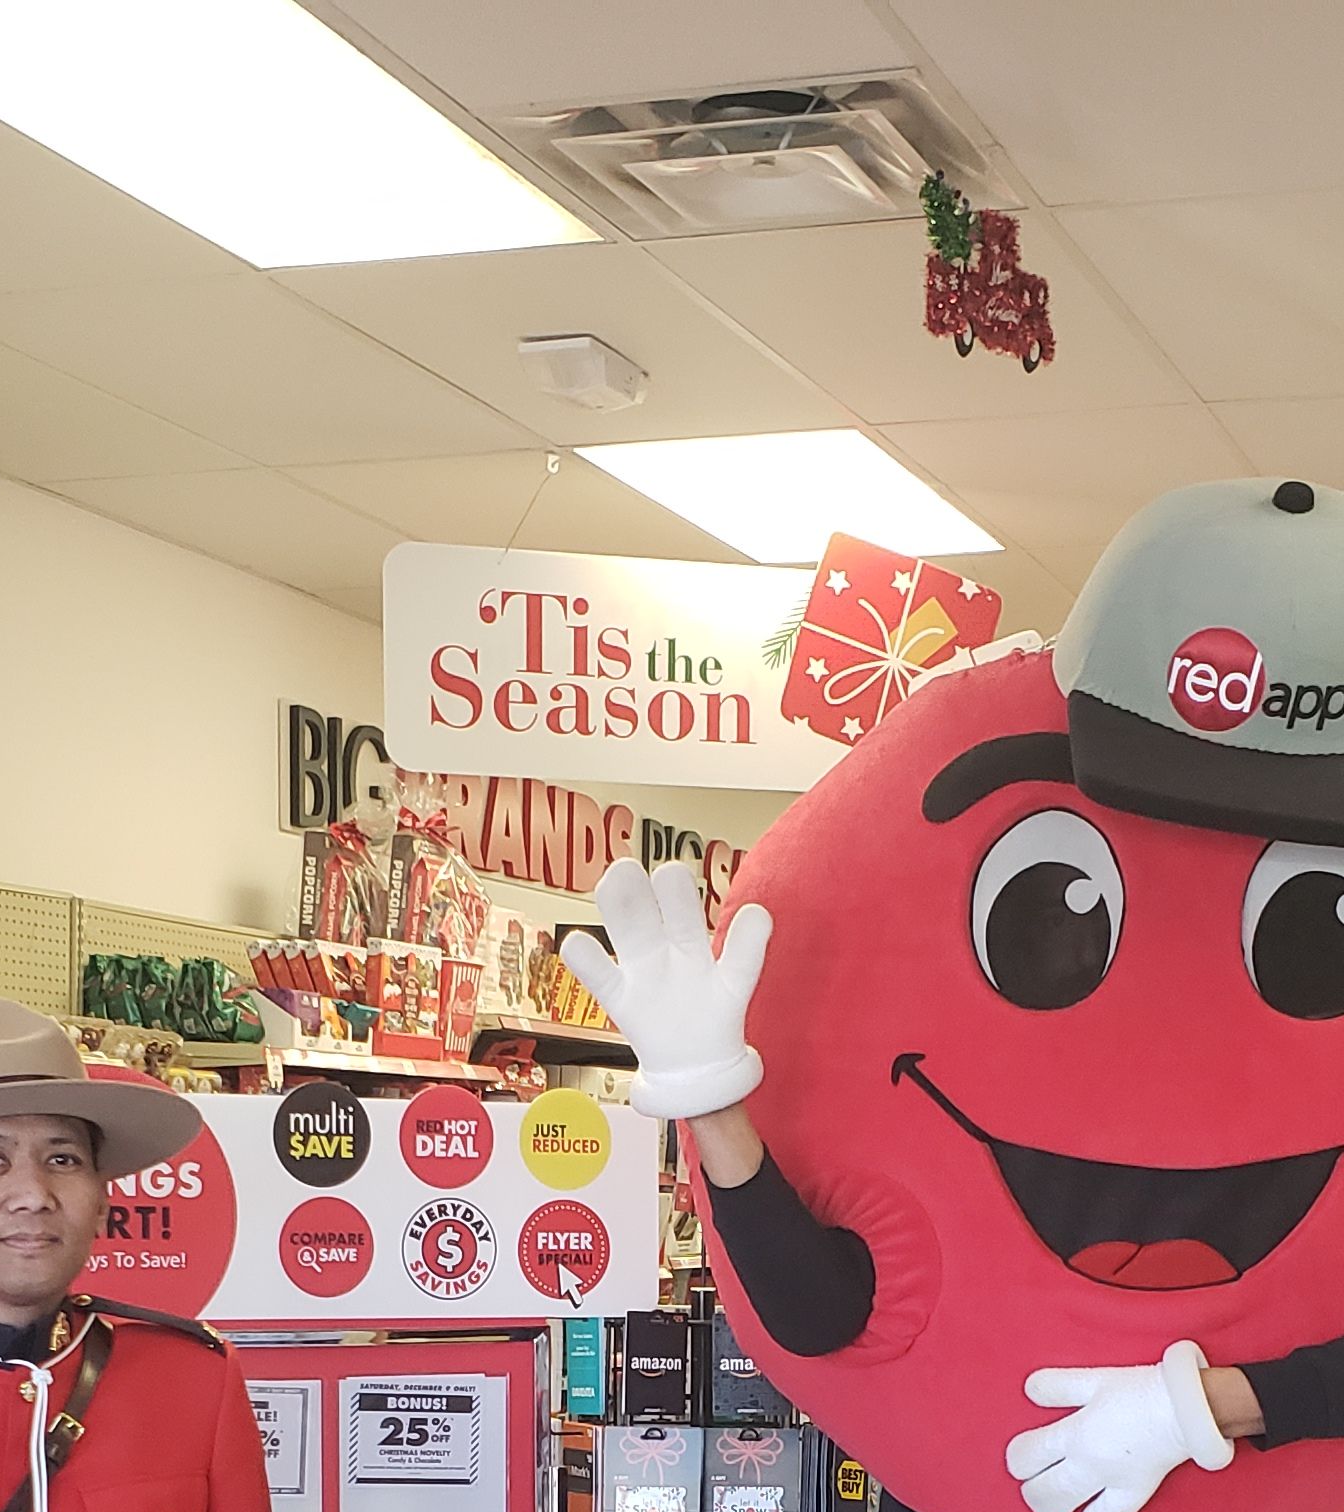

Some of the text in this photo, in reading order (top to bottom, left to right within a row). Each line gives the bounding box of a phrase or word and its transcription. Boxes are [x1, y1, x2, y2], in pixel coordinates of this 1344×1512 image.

[479, 588, 722, 685] 'Tis the
[1168, 652, 1263, 713] red
[429, 644, 757, 745] Season
[302, 856, 316, 926] POPCORN
[388, 860, 404, 929] POPCORN
[289, 1101, 354, 1133] multi
[532, 1124, 566, 1139] JUST
[290, 1133, 354, 1160] $AVE
[416, 1136, 479, 1158] DEAL
[532, 1138, 601, 1154] REDUCED
[106, 1205, 171, 1240] RT!
[409, 1203, 493, 1244] EVERYDAY
[290, 1232, 365, 1246] COMPARE
[537, 1231, 593, 1250] FLYER
[114, 1252, 135, 1267] To
[140, 1251, 187, 1268] Save!
[319, 1247, 358, 1263] SAVE
[409, 1260, 489, 1295] SAVINGS
[631, 1356, 682, 1371] amazon
[719, 1356, 758, 1371] ama
[404, 1384, 443, 1392] DECEMBER
[387, 1396, 448, 1411] BONUS!
[256, 1411, 278, 1422] LE!
[431, 1434, 451, 1444] OFF
[379, 1449, 451, 1457] CHRISTMAS NOVELTY
[841, 1469, 864, 1481] BEST
[841, 1481, 861, 1494] BUY
